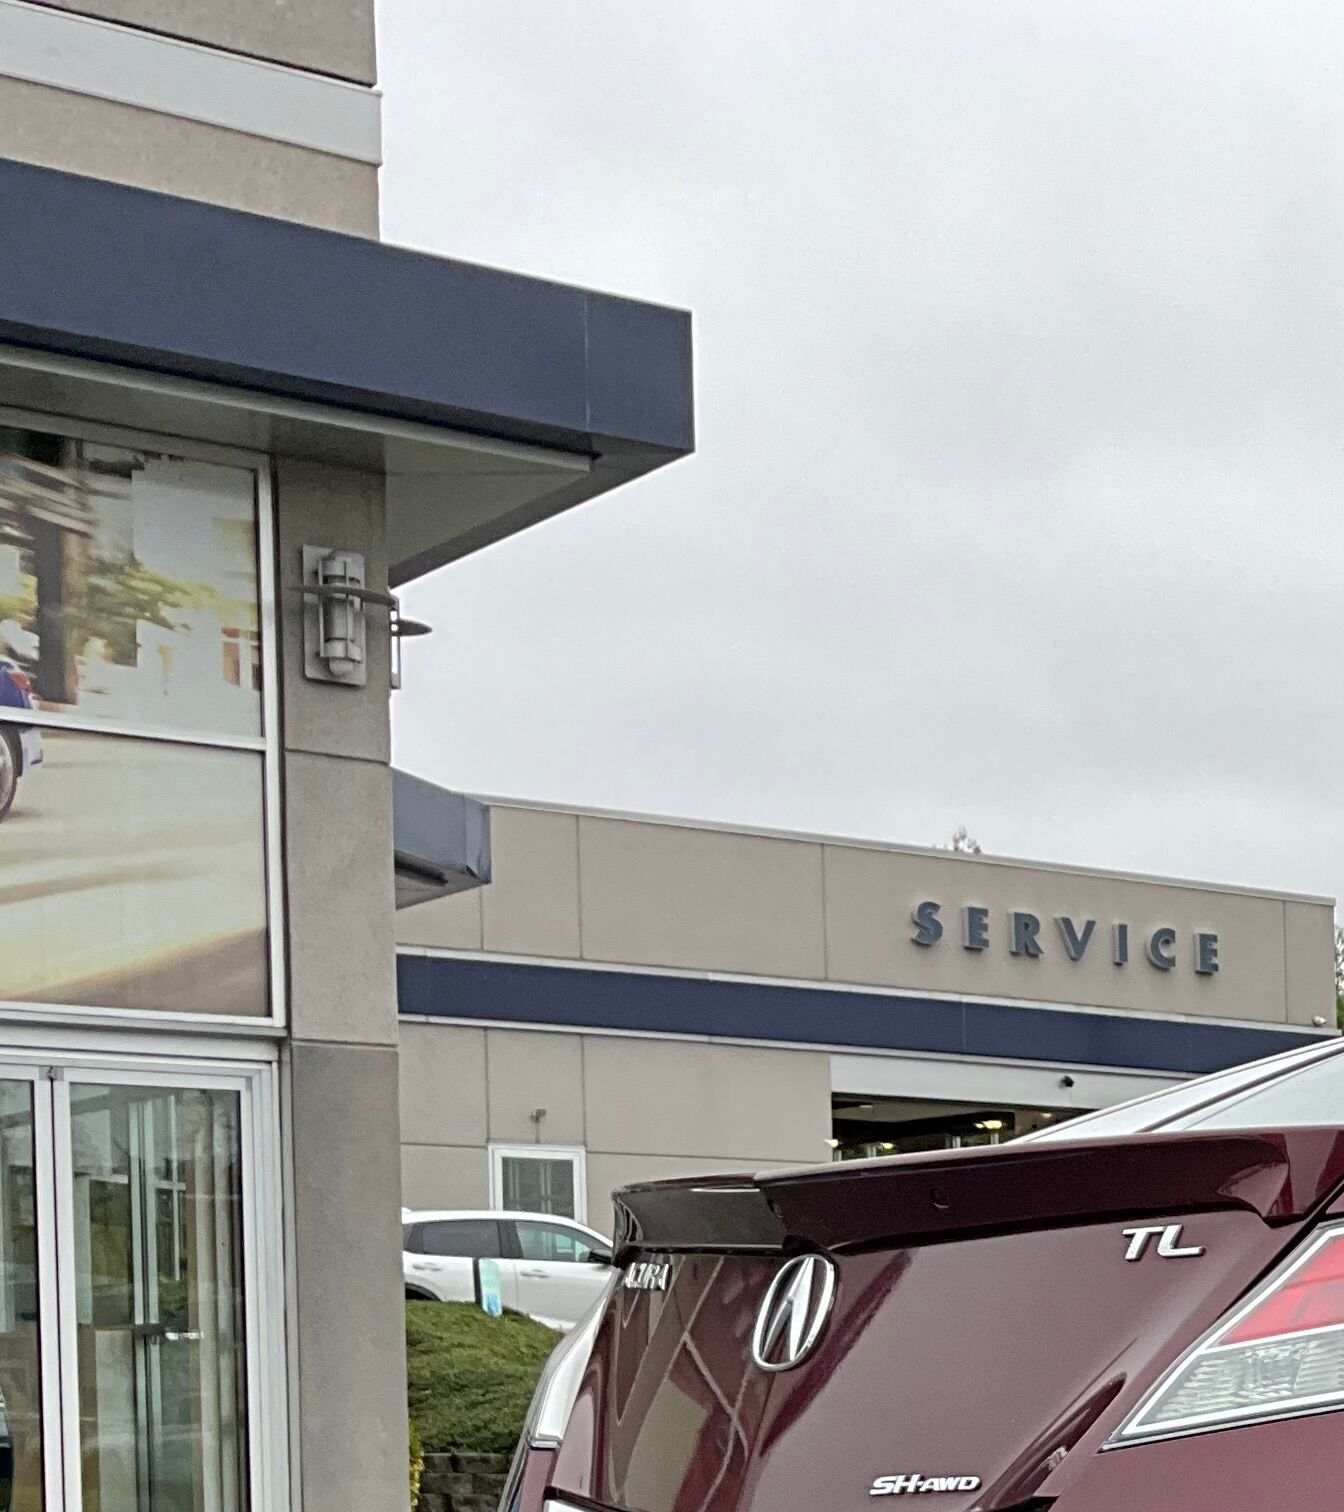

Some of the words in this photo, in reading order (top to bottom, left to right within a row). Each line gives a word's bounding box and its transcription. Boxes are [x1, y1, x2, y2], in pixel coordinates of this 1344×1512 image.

[911, 901, 1219, 974] SERVICE
[1122, 1224, 1206, 1261] TL
[869, 1474, 981, 1496] SH-AWD
